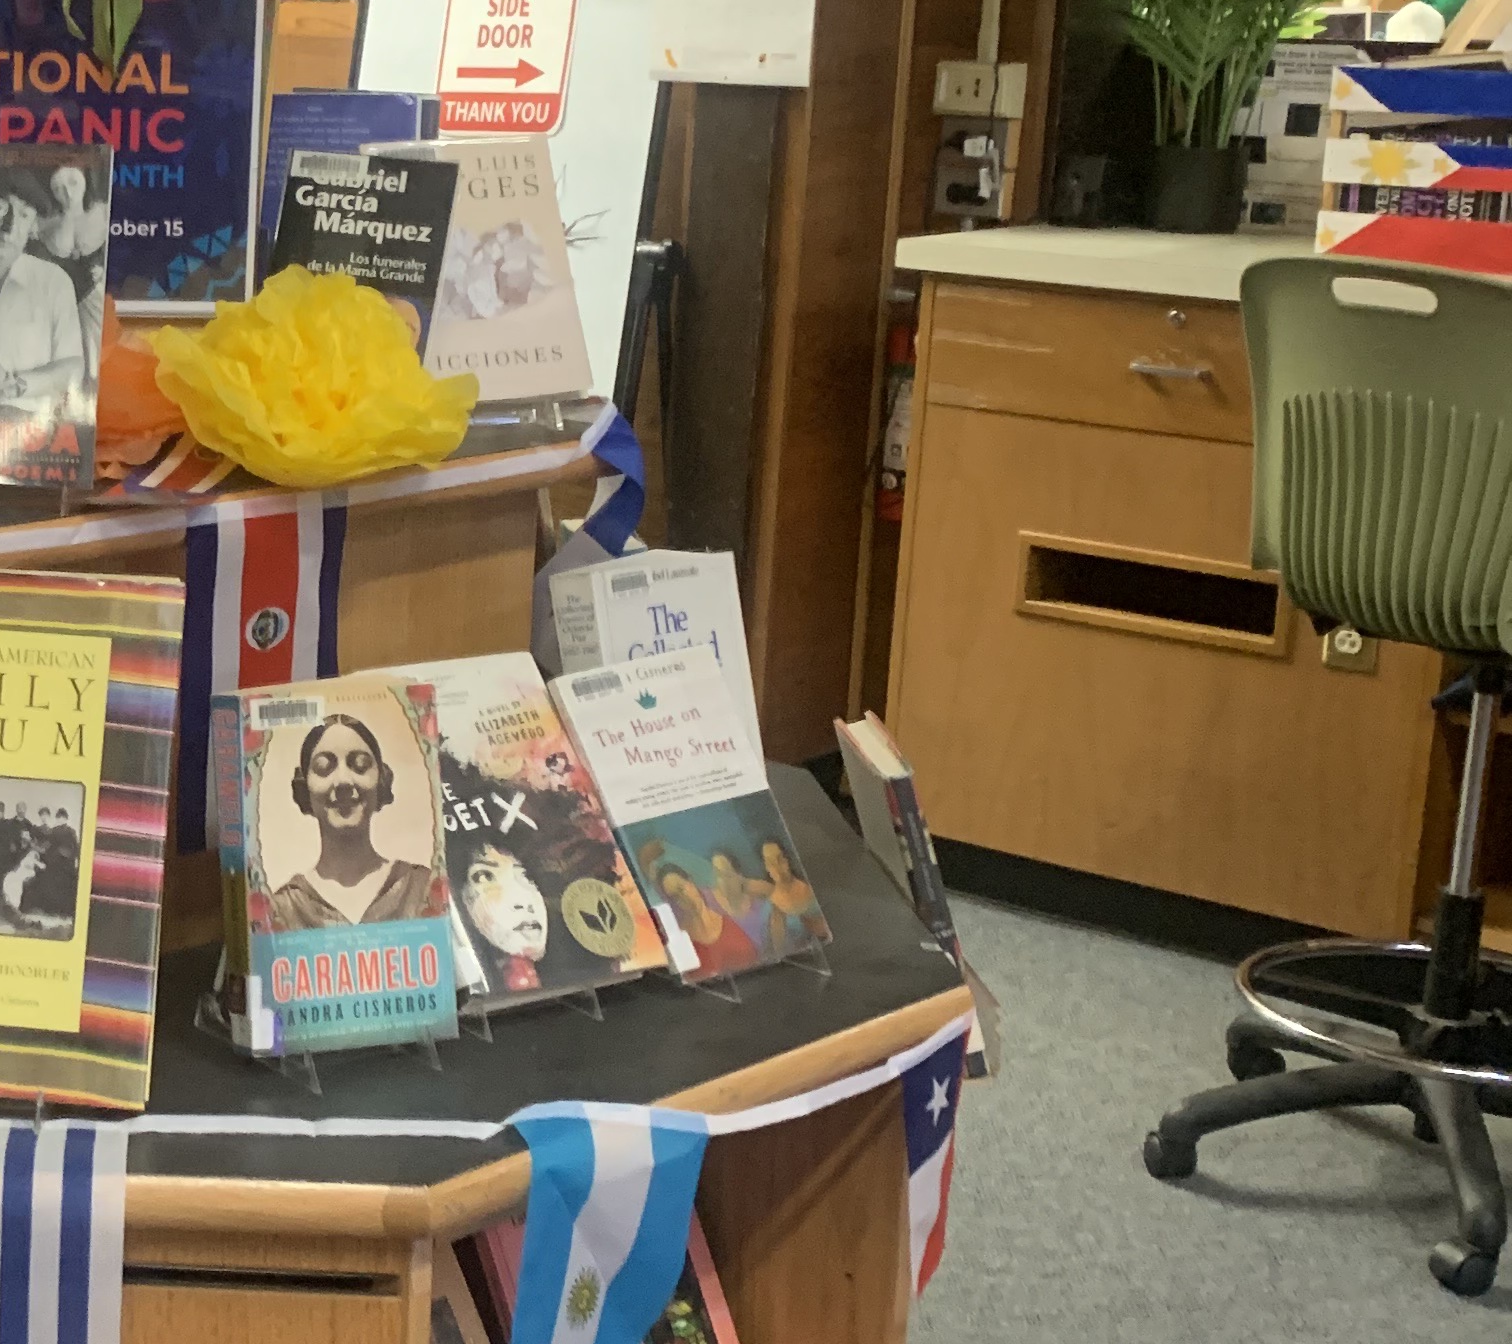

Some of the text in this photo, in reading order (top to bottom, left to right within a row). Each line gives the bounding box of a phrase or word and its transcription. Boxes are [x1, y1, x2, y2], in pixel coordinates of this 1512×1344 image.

[477, 24, 534, 48] DOOR
[445, 100, 550, 123] THANK YOU
[477, 154, 536, 171] LUIS
[115, 163, 185, 189] NTH
[295, 185, 378, 213] García
[110, 219, 184, 237] ober 15
[314, 210, 432, 244] Márquez
[307, 260, 425, 284] de la Mamá Grande
[350, 252, 428, 271] Los funerales
[438, 346, 564, 370] ICCIONES
[647, 603, 688, 636] The
[636, 661, 686, 680] Cisneros
[474, 709, 540, 733] ELIZABETH
[592, 707, 702, 747] The House on
[488, 726, 545, 745] ACEVEDO
[624, 736, 737, 767] Mango Street
[444, 792, 538, 834] OET X
[0, 963, 71, 982] HOOBLER
[271, 943, 439, 1004] CARAMELO
[353, 993, 437, 1019] CISNEROS
